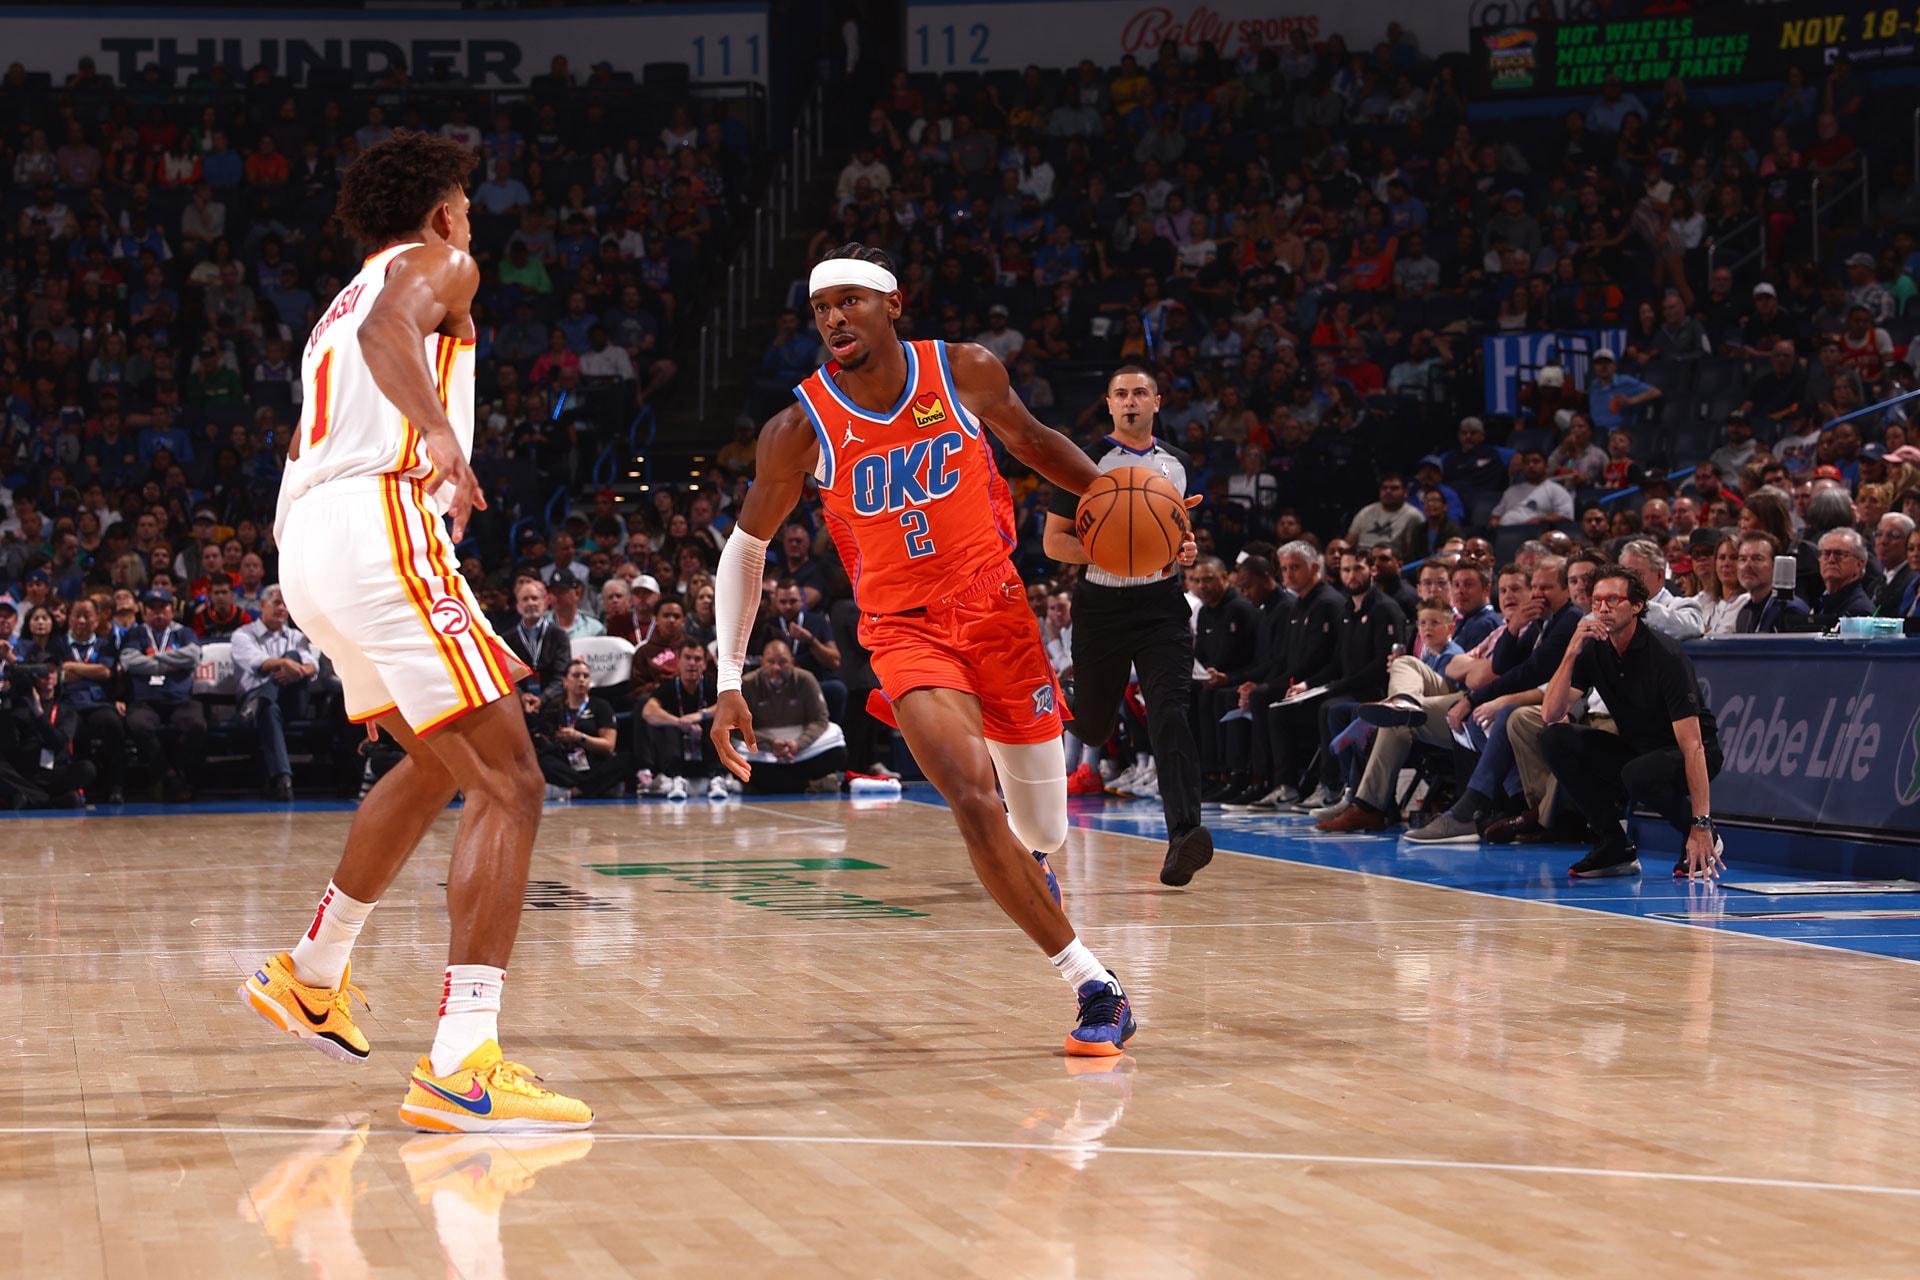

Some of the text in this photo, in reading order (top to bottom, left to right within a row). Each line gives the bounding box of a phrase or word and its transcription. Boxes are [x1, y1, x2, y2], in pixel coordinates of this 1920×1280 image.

[915, 23, 990, 65] 112
[1121, 7, 1235, 55] Bally
[1237, 16, 1320, 43] SPORTS
[1555, 17, 1695, 47] HOT WHEELS
[1555, 33, 1750, 67] MONSTER TRUCKS
[1779, 15, 1848, 49] NOV.
[101, 37, 522, 84] THUNDER
[691, 35, 761, 77] 111
[1555, 65, 1607, 87] LIVE
[1678, 55, 1746, 79] PARTY
[309, 346, 335, 450] 1
[852, 431, 963, 516] OKC
[900, 510, 936, 559] 2
[1716, 693, 1881, 782] Globe Life
